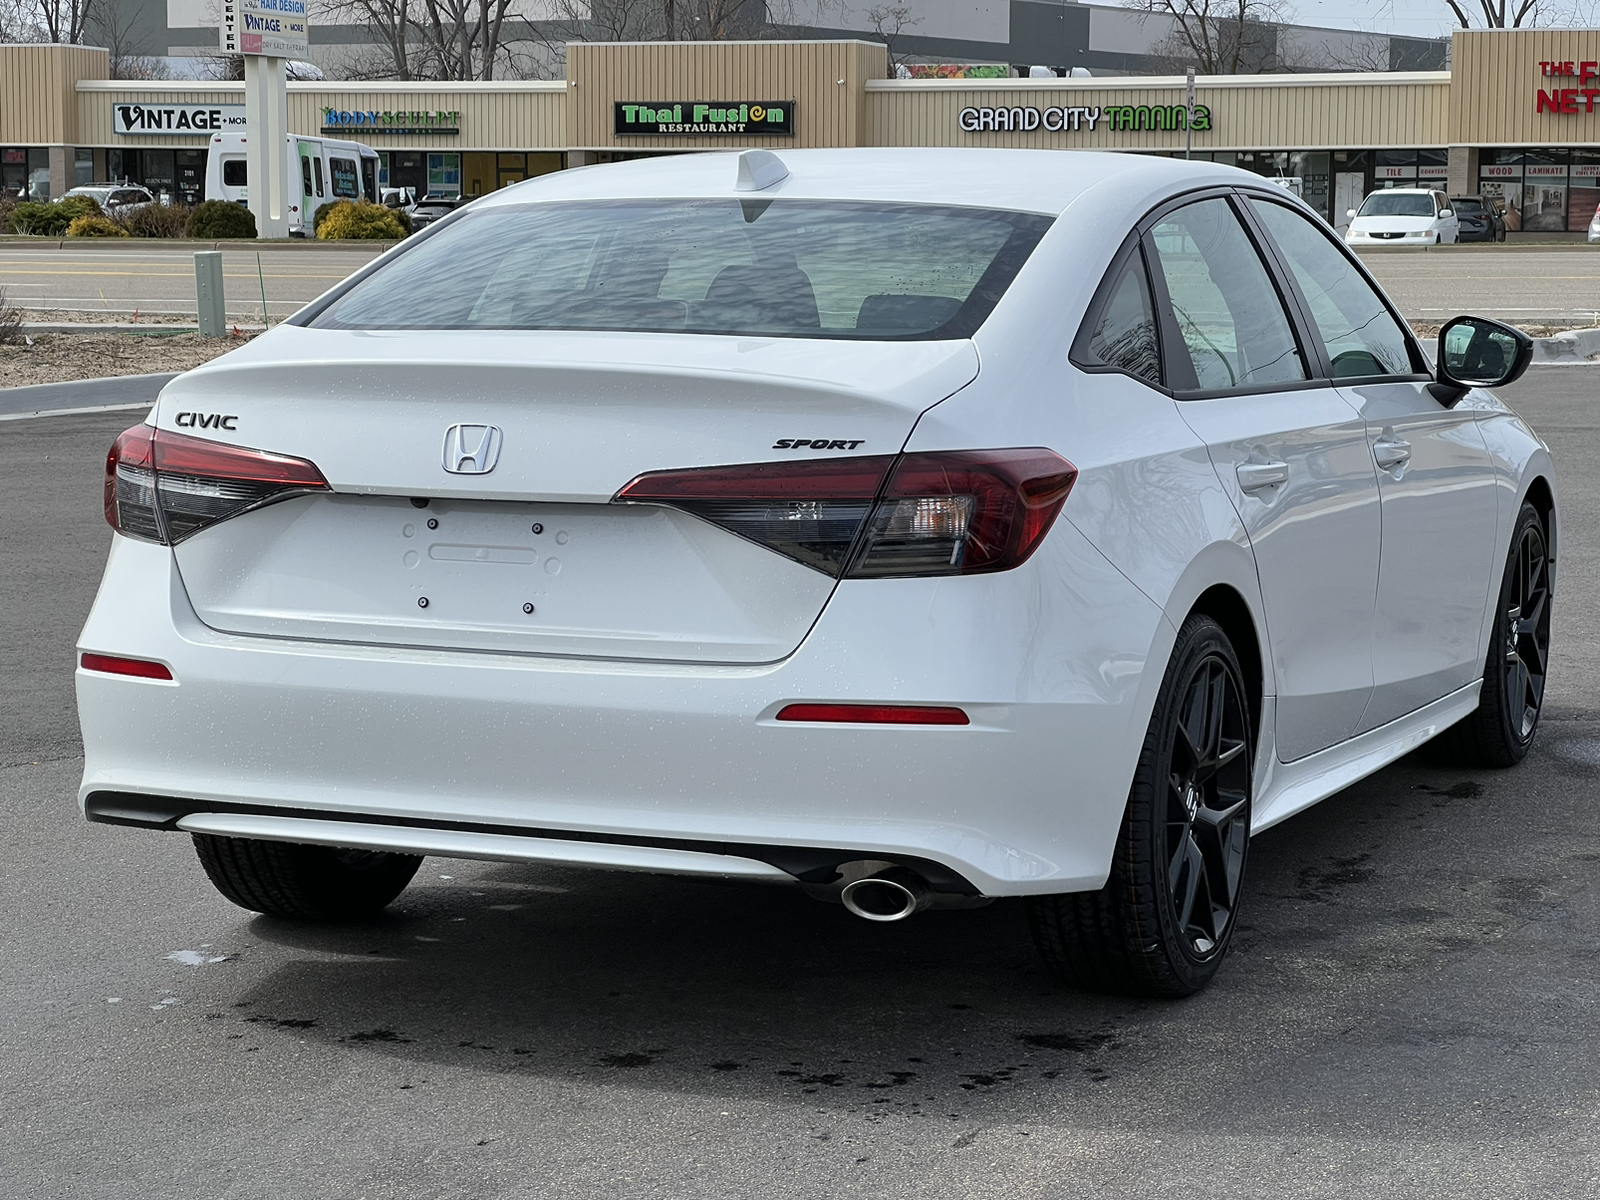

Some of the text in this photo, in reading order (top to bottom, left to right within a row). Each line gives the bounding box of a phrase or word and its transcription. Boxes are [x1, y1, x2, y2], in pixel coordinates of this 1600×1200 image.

[260, 0, 305, 14] HAIR DESIGN
[289, 23, 304, 32] MORE
[262, 41, 272, 49] DRY
[273, 42, 285, 50] SALT
[286, 43, 308, 52] THERAPY
[1538, 61, 1600, 86] THE F
[1536, 88, 1600, 114] NET
[117, 105, 222, 131] VINTAGE
[228, 117, 247, 125] MOR
[622, 103, 784, 123] Thai Fusion
[958, 105, 1212, 132] GRAND CITY TANNING
[658, 123, 746, 133] RESTAURANT
[1386, 168, 1403, 177] TILE
[1488, 167, 1513, 175] WOOD
[1528, 167, 1563, 175] LAMINATE
[174, 411, 239, 431] CIVIC
[771, 439, 866, 450] SPORT
